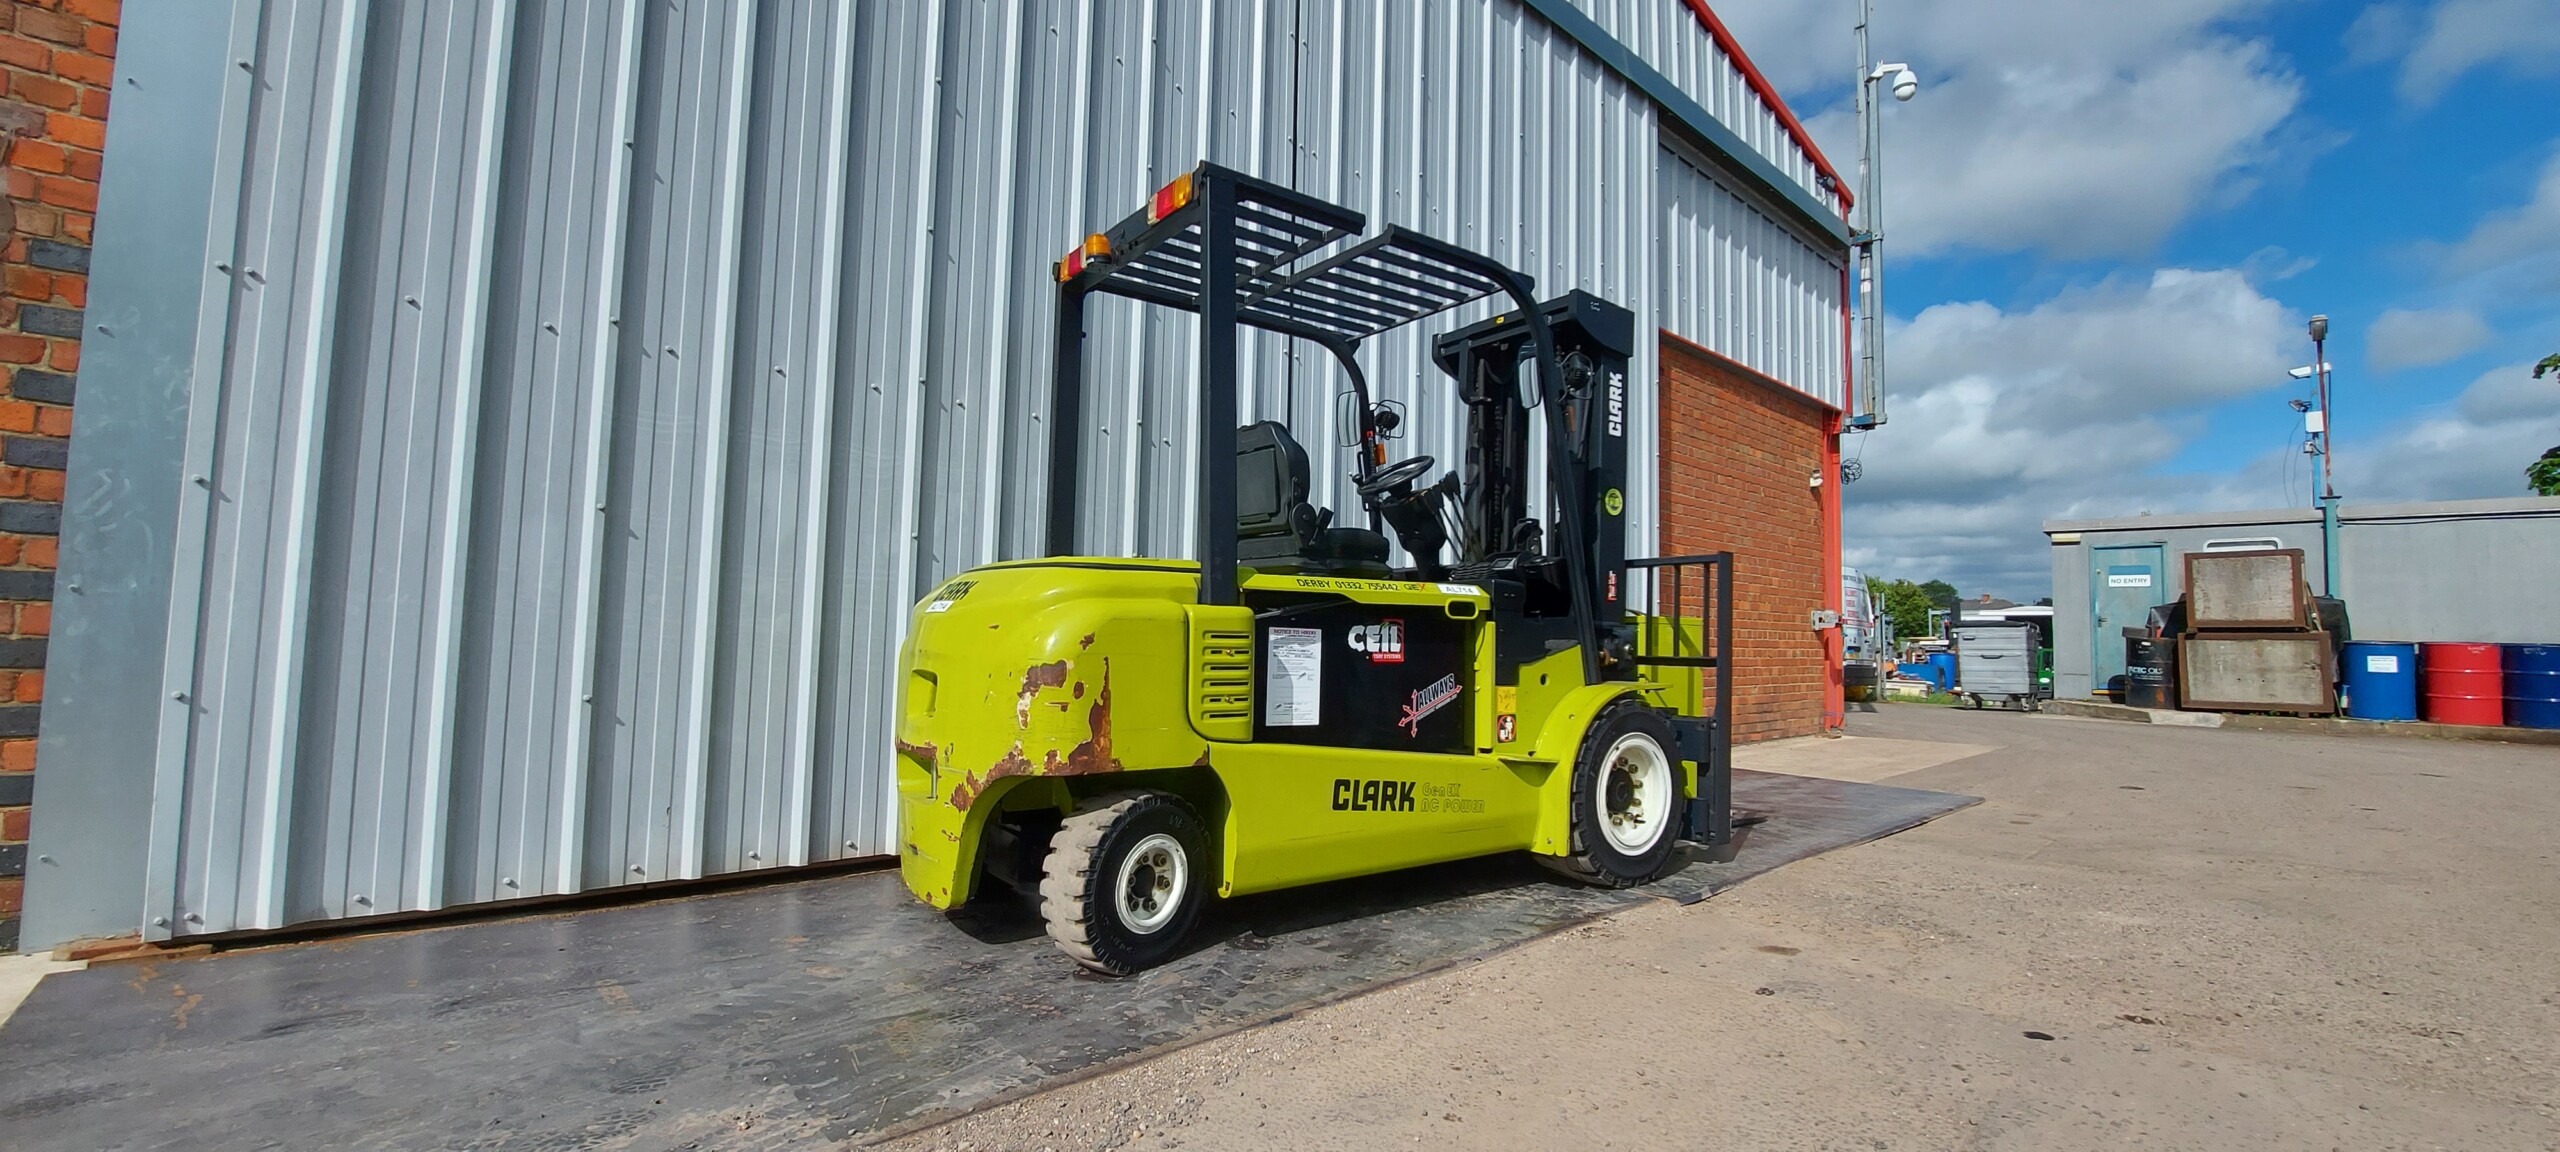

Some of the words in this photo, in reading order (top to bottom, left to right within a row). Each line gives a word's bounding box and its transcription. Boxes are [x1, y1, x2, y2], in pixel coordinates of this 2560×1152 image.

[1608, 371, 1623, 437] CLARK
[1296, 578, 1331, 589] DERBY
[1335, 580, 1364, 590] 01332
[1367, 582, 1399, 591] 755442
[1403, 583, 1426, 592] GEX
[1446, 585, 1473, 594] AL714
[1417, 673, 1454, 710] ALLWAYS
[1332, 778, 1416, 812] CLARK
